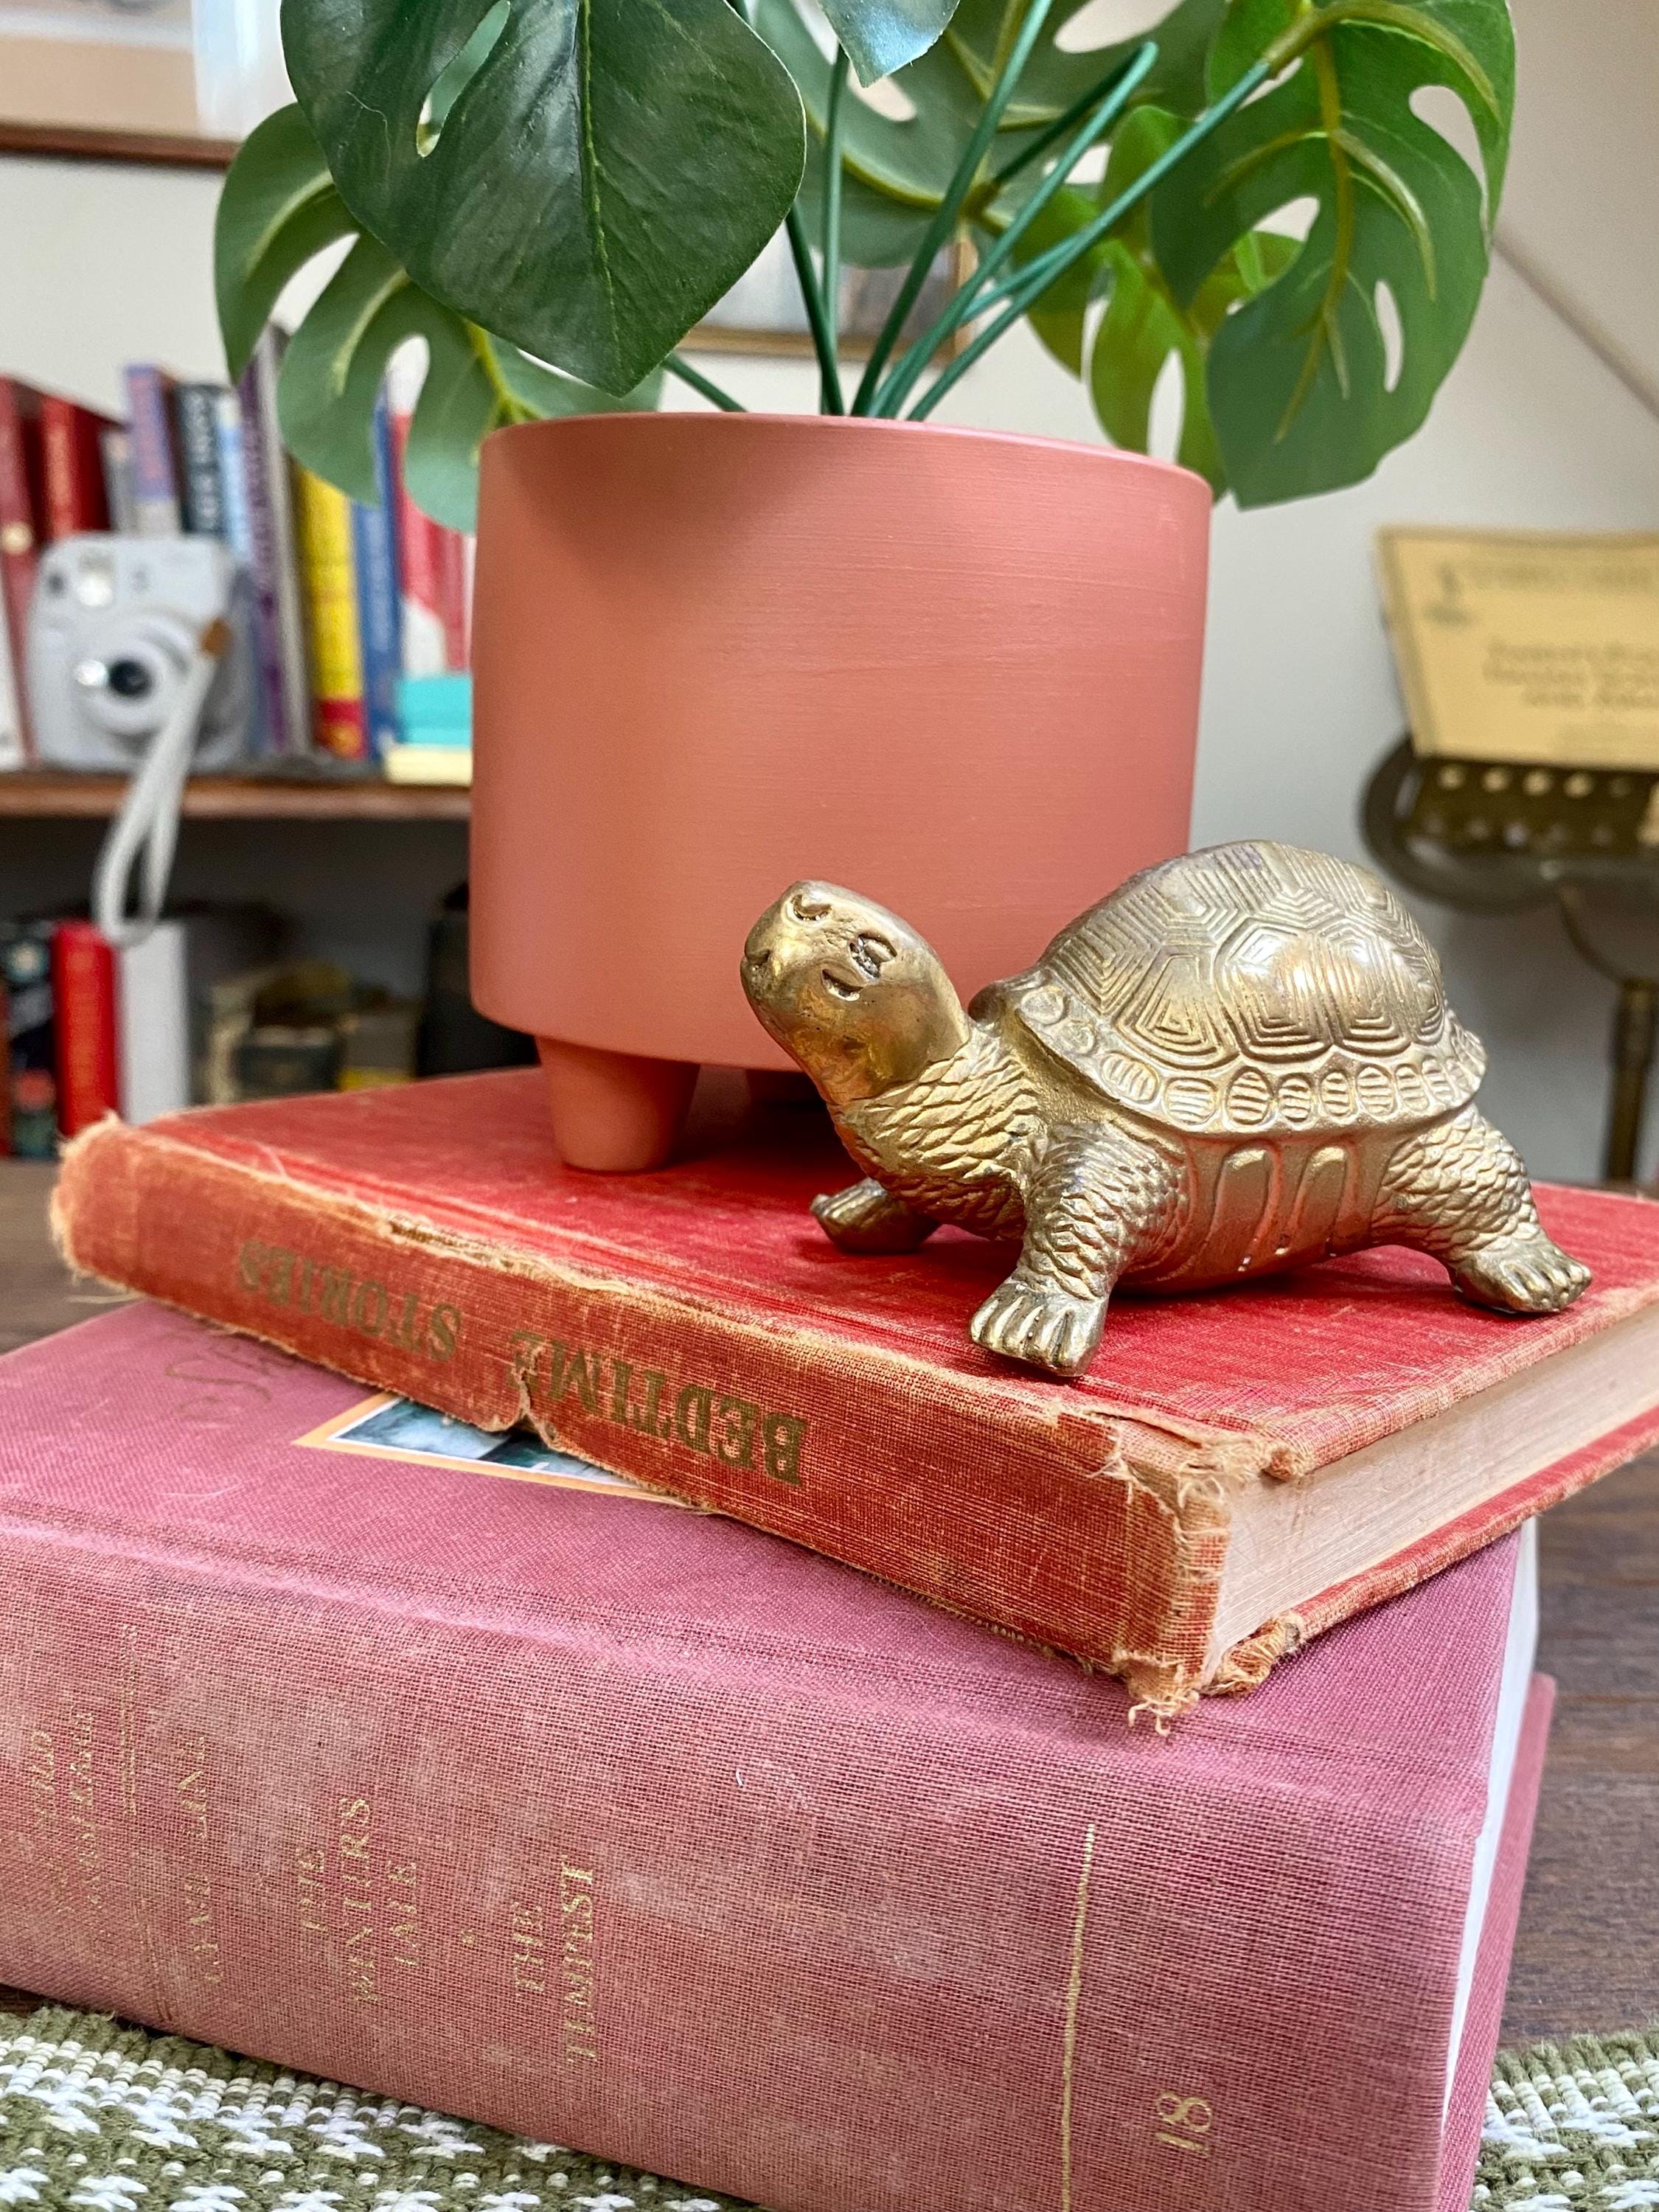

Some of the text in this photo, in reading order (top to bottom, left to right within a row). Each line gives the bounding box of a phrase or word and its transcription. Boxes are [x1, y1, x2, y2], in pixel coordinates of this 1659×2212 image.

[238, 1239, 807, 1486] BEDTIME STORIES
[512, 1901, 545, 1994] THE
[560, 1854, 597, 2063] TEMPEST
[1155, 2092, 1212, 2158] 18
